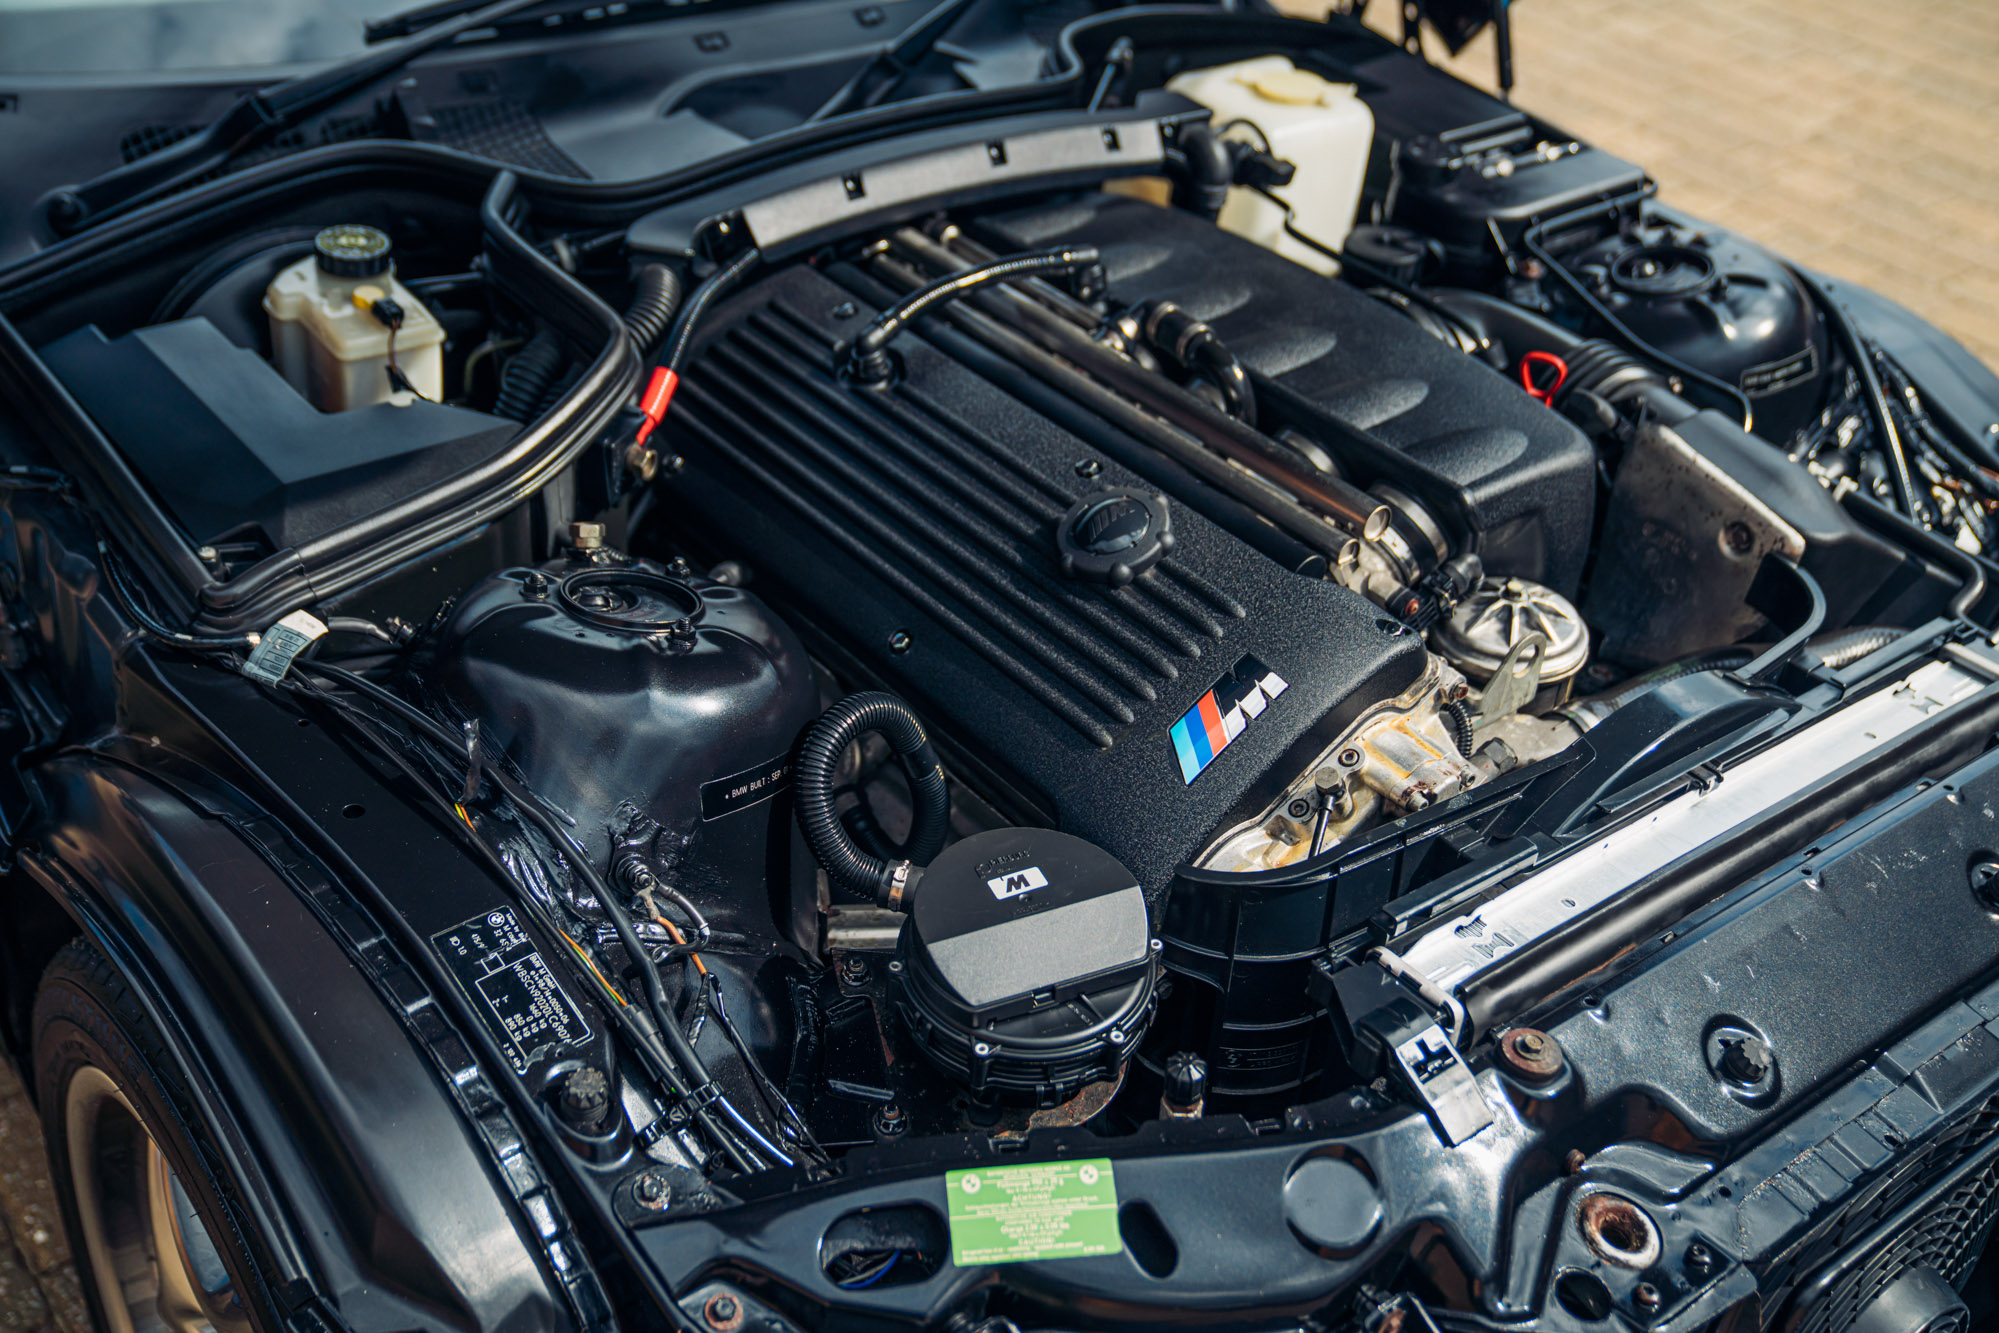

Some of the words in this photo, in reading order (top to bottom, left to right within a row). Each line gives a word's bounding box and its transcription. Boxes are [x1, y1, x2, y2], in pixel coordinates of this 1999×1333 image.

[731, 785, 748, 798] BMW
[750, 777, 766, 791] BUILT
[1006, 873, 1031, 893] M
[502, 924, 511, 932] M
[529, 955, 542, 968] BMW
[538, 967, 547, 975] M
[543, 974, 556, 990] GmbH
[505, 1017, 517, 1030] 890
[514, 1031, 523, 1042] kg
[513, 1013, 526, 1026] 850
[522, 1026, 531, 1037] kg
[530, 1022, 540, 1033] kg
[539, 1018, 548, 1030] kg
